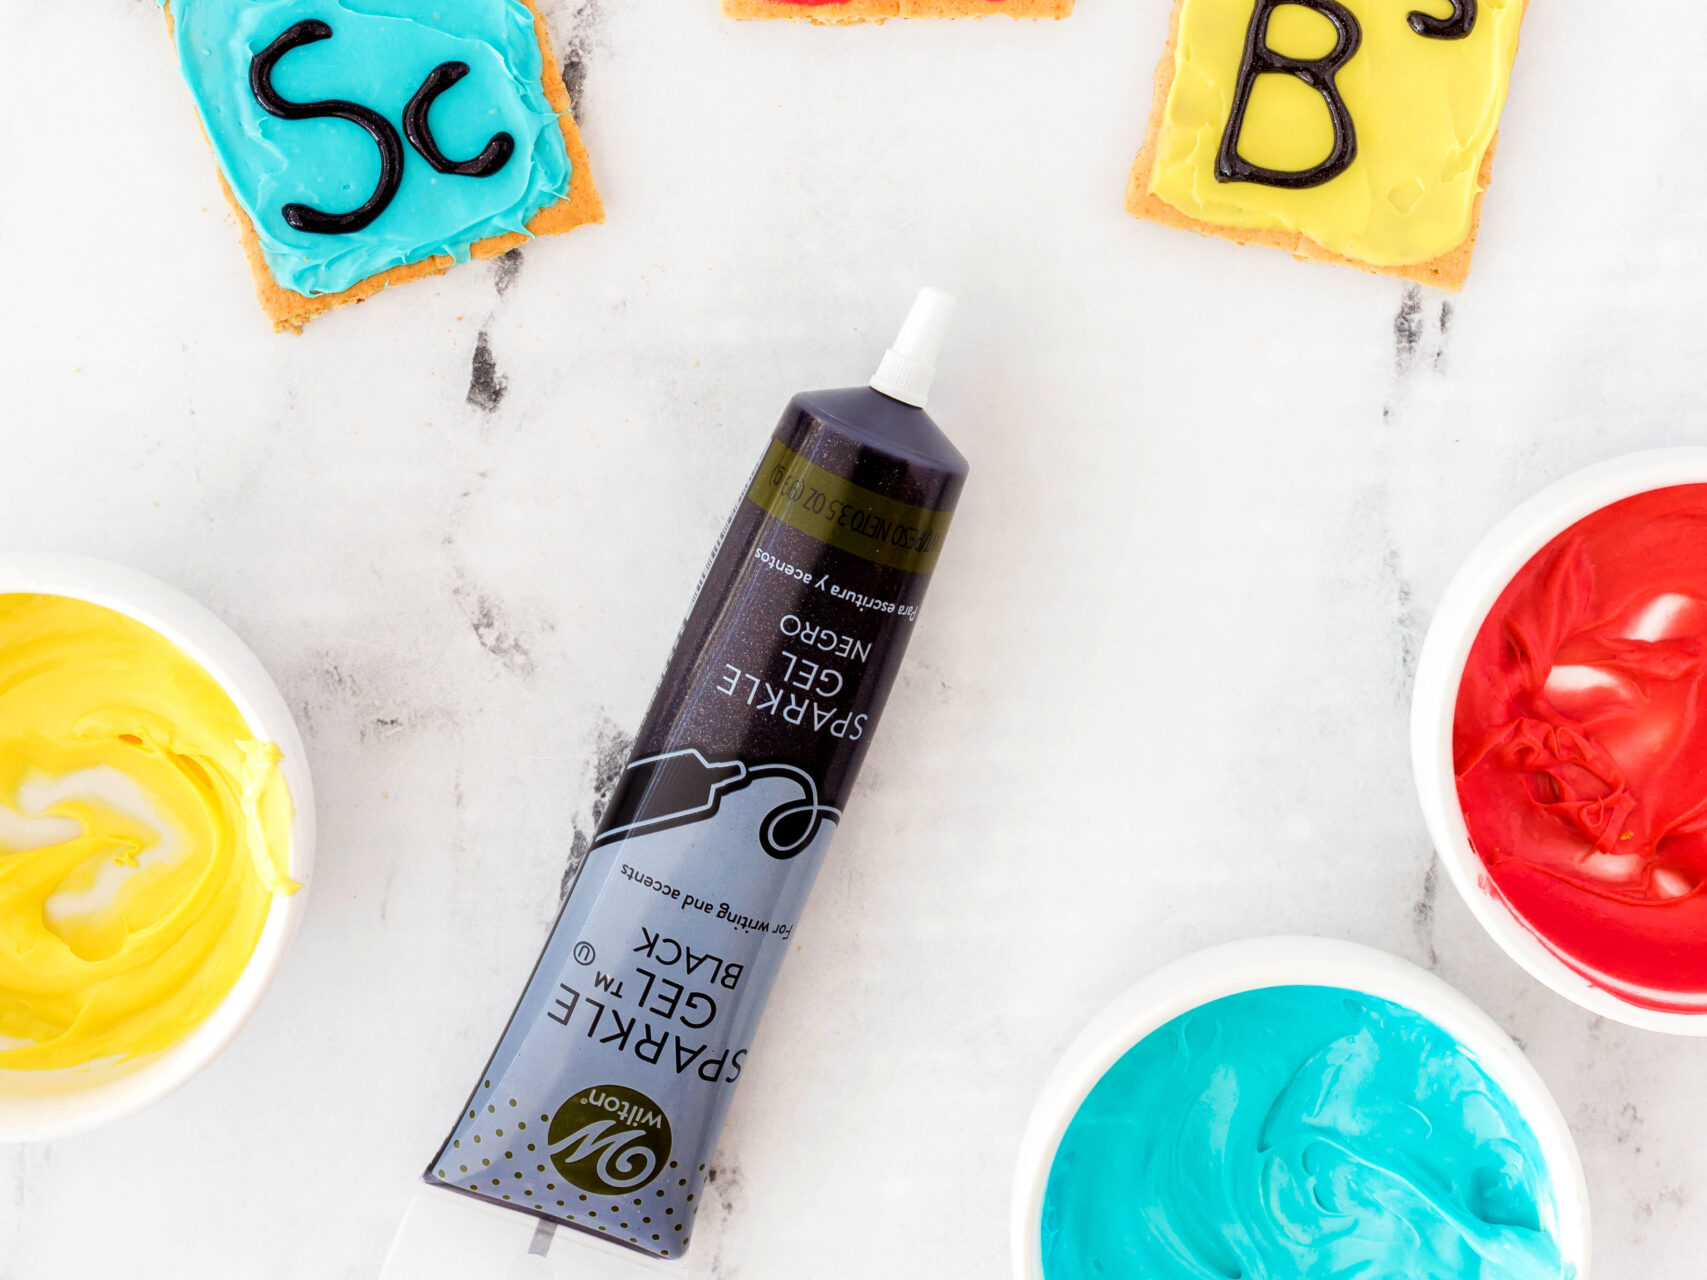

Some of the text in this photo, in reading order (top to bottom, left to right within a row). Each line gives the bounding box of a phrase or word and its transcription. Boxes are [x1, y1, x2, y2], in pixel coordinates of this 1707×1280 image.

[249, 19, 514, 235] Sc
[802, 487, 826, 514] OZ
[825, 499, 851, 527] 3.5
[851, 509, 892, 542] NETO
[754, 547, 919, 622] Para escritura y acentos
[779, 614, 872, 663] NEGRO
[716, 663, 869, 741] SPARKLE
[781, 650, 844, 697] GEL
[620, 863, 794, 940] For writing and accents
[633, 926, 745, 990] BLACK
[547, 982, 748, 1084] SPARKLE
